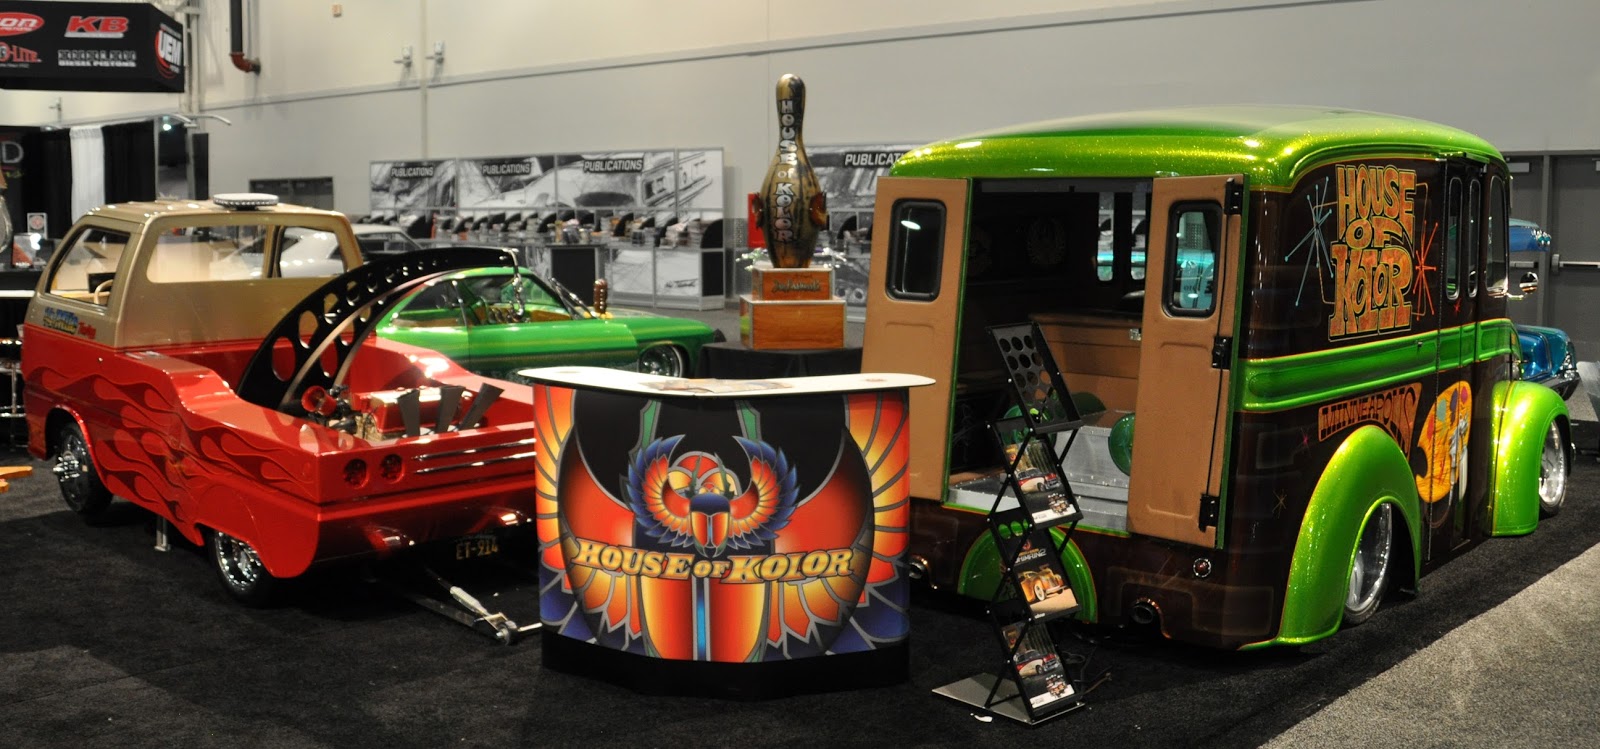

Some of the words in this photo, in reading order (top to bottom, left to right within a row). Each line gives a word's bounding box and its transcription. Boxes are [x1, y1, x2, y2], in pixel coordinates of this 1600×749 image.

[0, 17, 37, 27] on
[66, 16, 129, 32] KB
[157, 30, 182, 66] UEM
[778, 99, 798, 165] HOUSE
[391, 166, 433, 178] PUBLICATIONS
[482, 163, 531, 175] PUBLICATIONS
[583, 159, 643, 173] PUBLICATIONS
[844, 152, 903, 166] PUBLICAT
[775, 183, 795, 242] KOLOR
[1336, 164, 1417, 243] HOUSE
[1345, 215, 1404, 249] OF
[1320, 387, 1417, 458] MINNEAPOLIS
[572, 537, 695, 580] HOUSE
[719, 548, 854, 584] KOLOR
